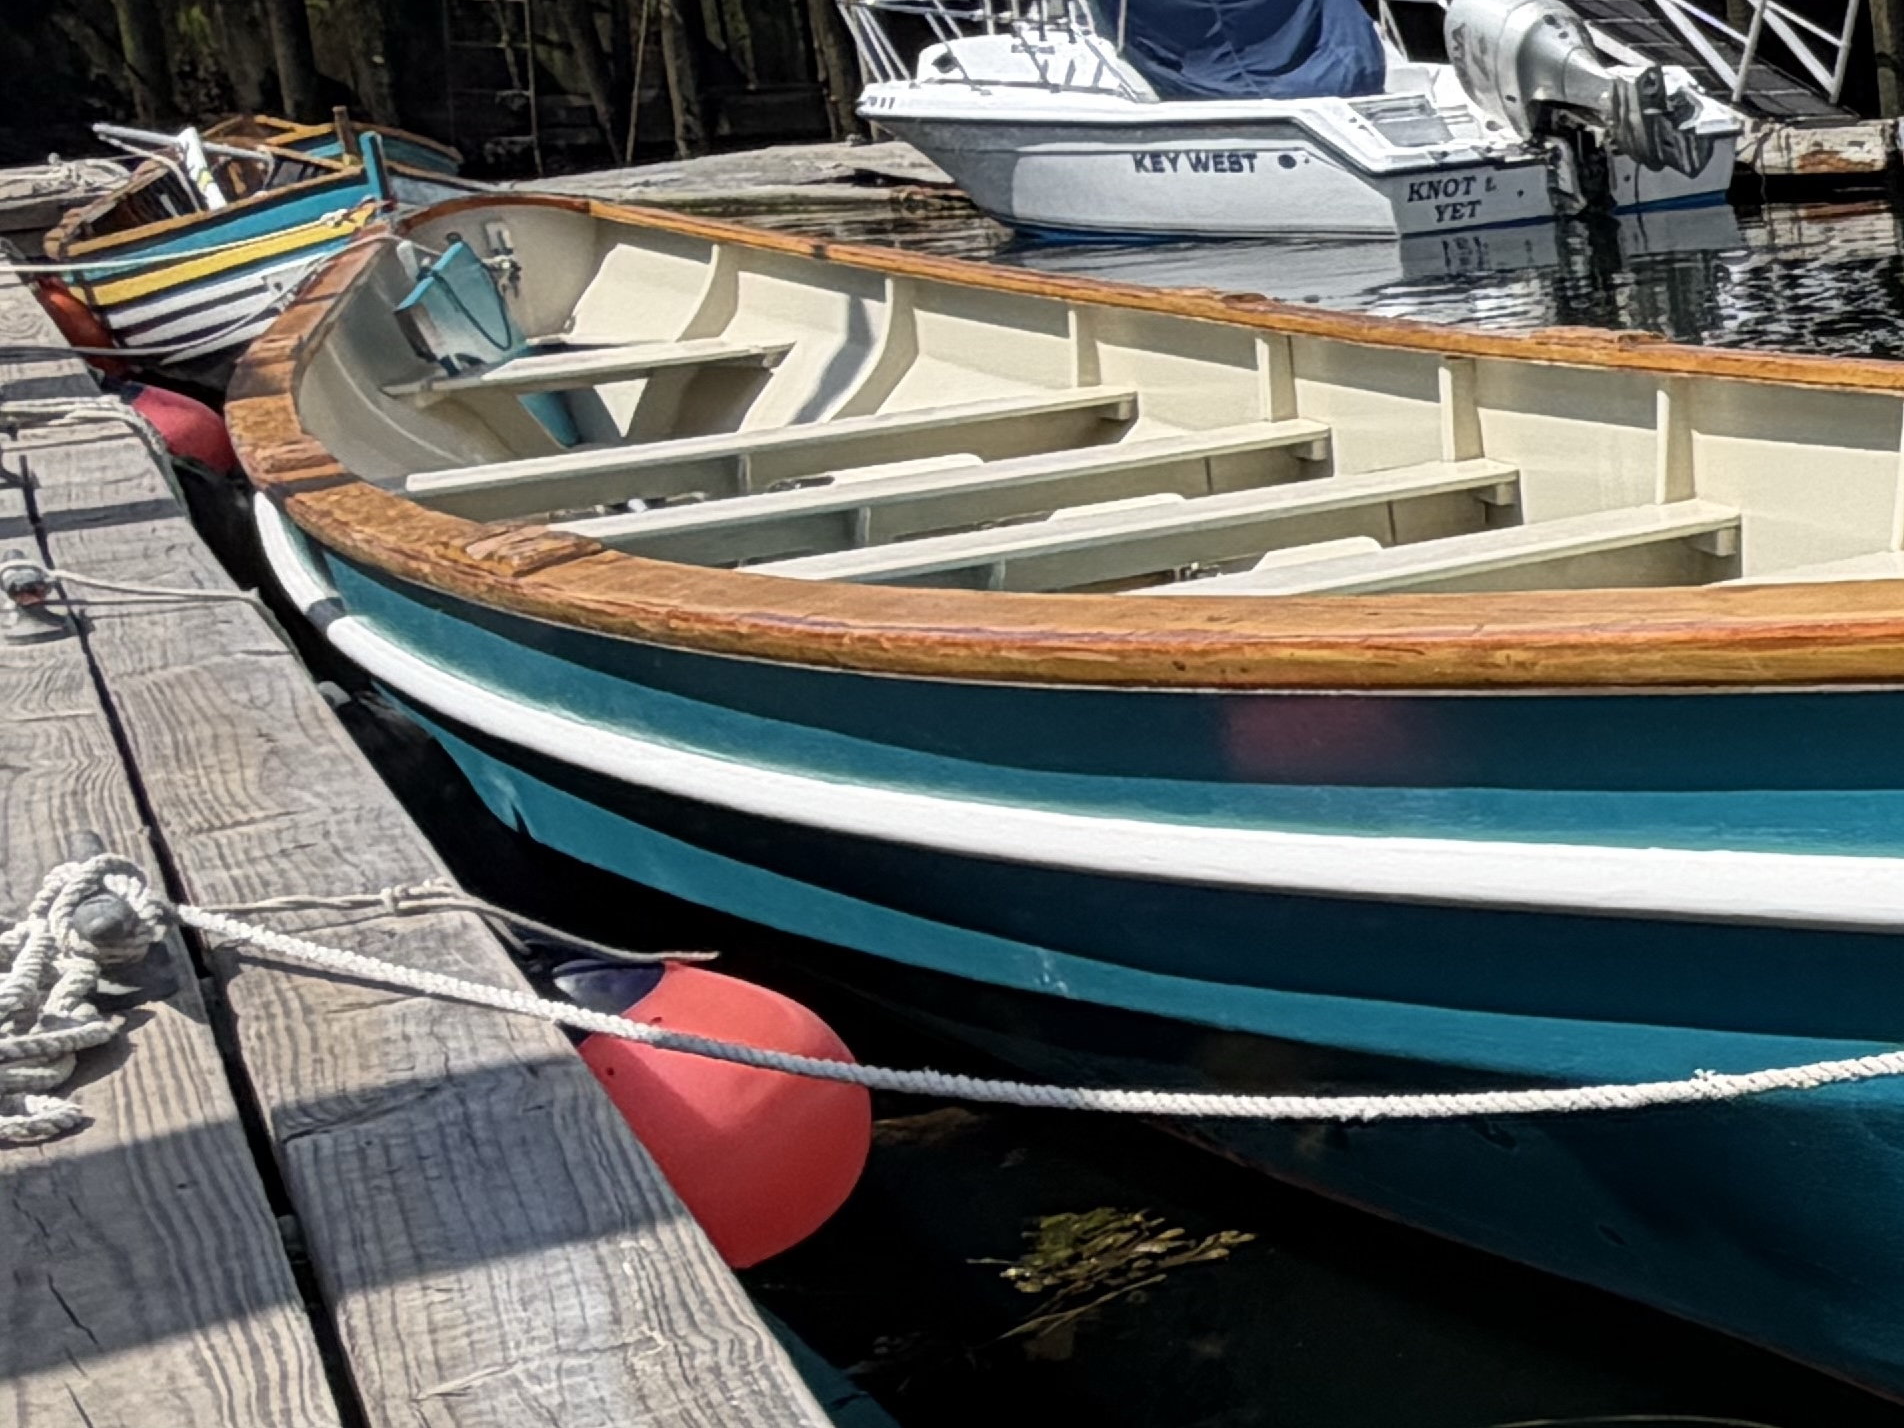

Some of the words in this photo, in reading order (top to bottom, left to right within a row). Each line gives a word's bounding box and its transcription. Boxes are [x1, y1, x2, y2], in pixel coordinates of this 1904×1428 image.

[1133, 152, 1179, 173] KEY
[1185, 152, 1257, 173] WEST
[1407, 175, 1476, 203] KNOT
[1434, 199, 1482, 223] YET
